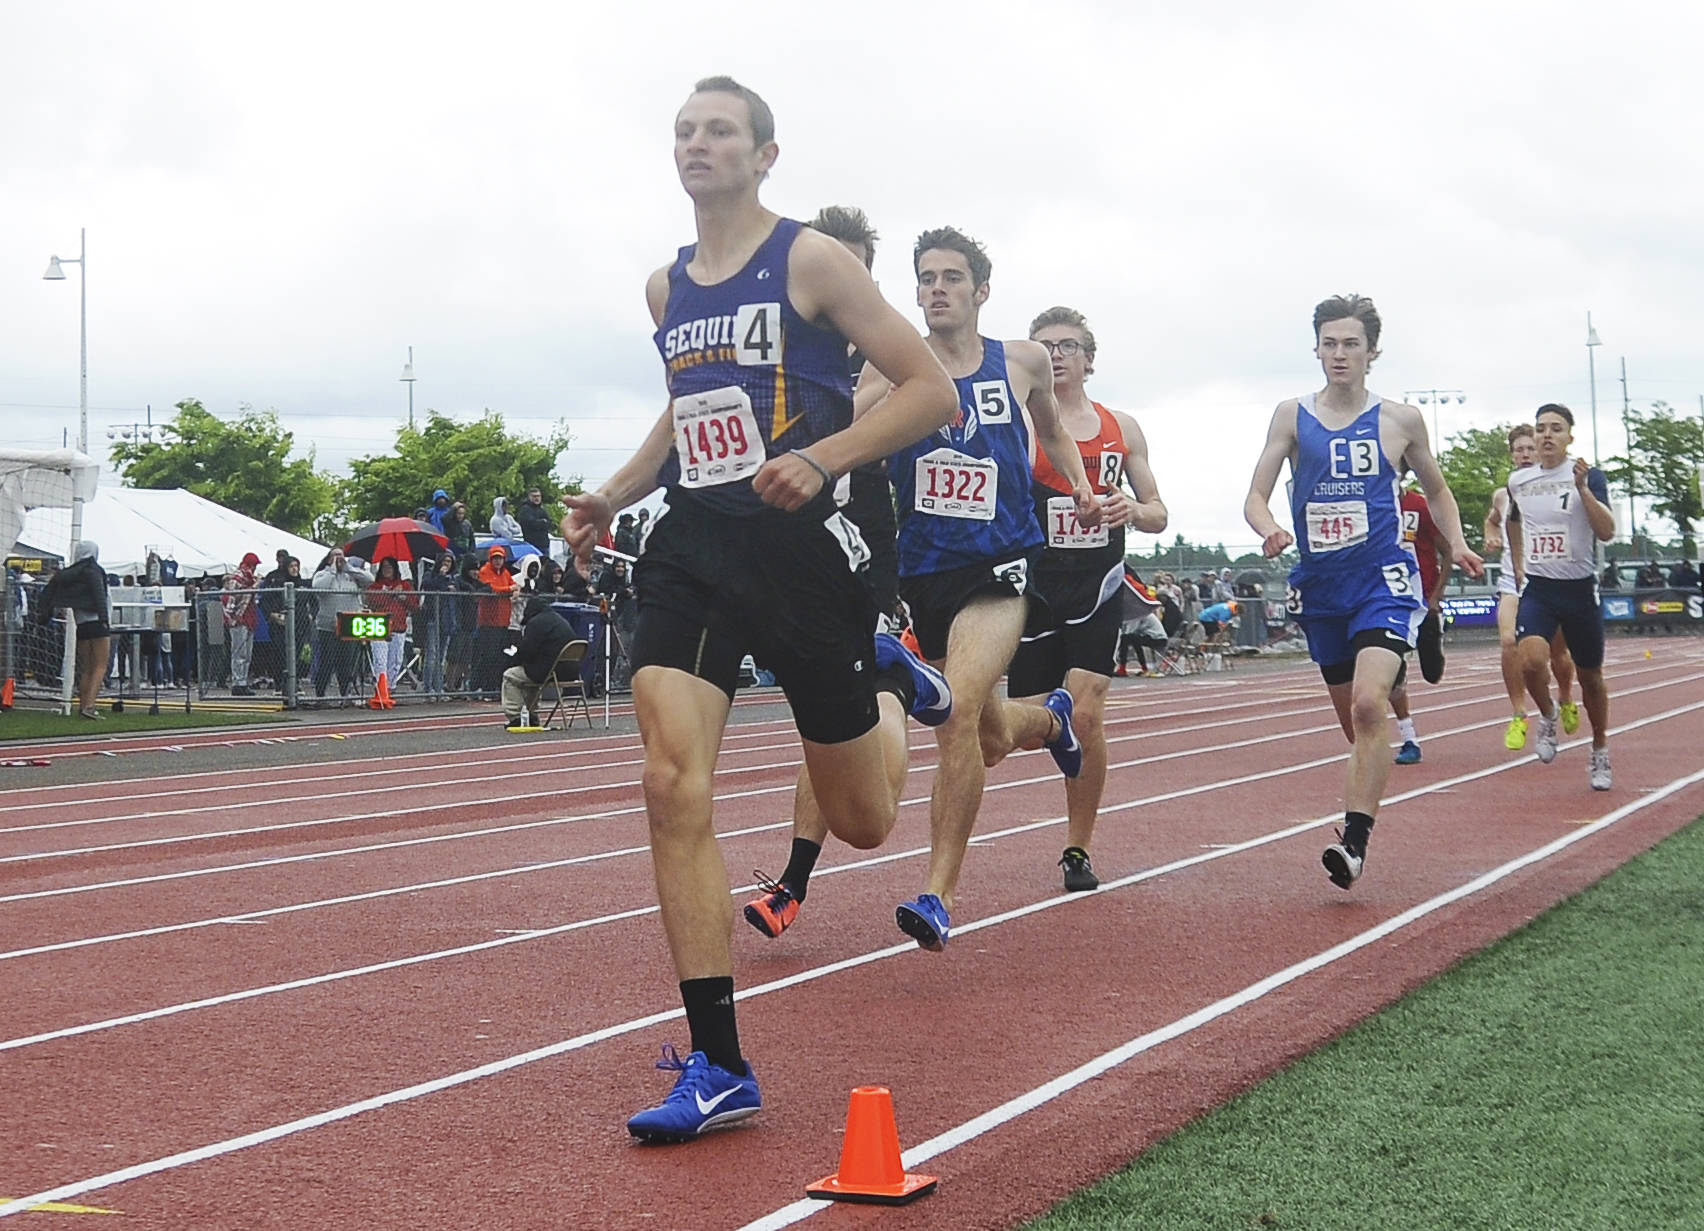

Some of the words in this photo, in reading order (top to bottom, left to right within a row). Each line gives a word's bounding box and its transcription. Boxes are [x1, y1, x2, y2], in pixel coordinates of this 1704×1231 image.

[744, 308, 773, 361] 4
[980, 387, 1005, 417] 5
[683, 415, 749, 465] 1439
[1104, 454, 1118, 483] 8
[1356, 442, 1373, 473] 3
[926, 467, 987, 502] 1322
[1313, 482, 1366, 496] CRUISERS
[1559, 491, 1570, 510] 1
[1320, 517, 1354, 540] 445
[1531, 536, 1565, 554] 1732
[1387, 566, 1408, 593] 3
[352, 617, 386, 637] 0:36
